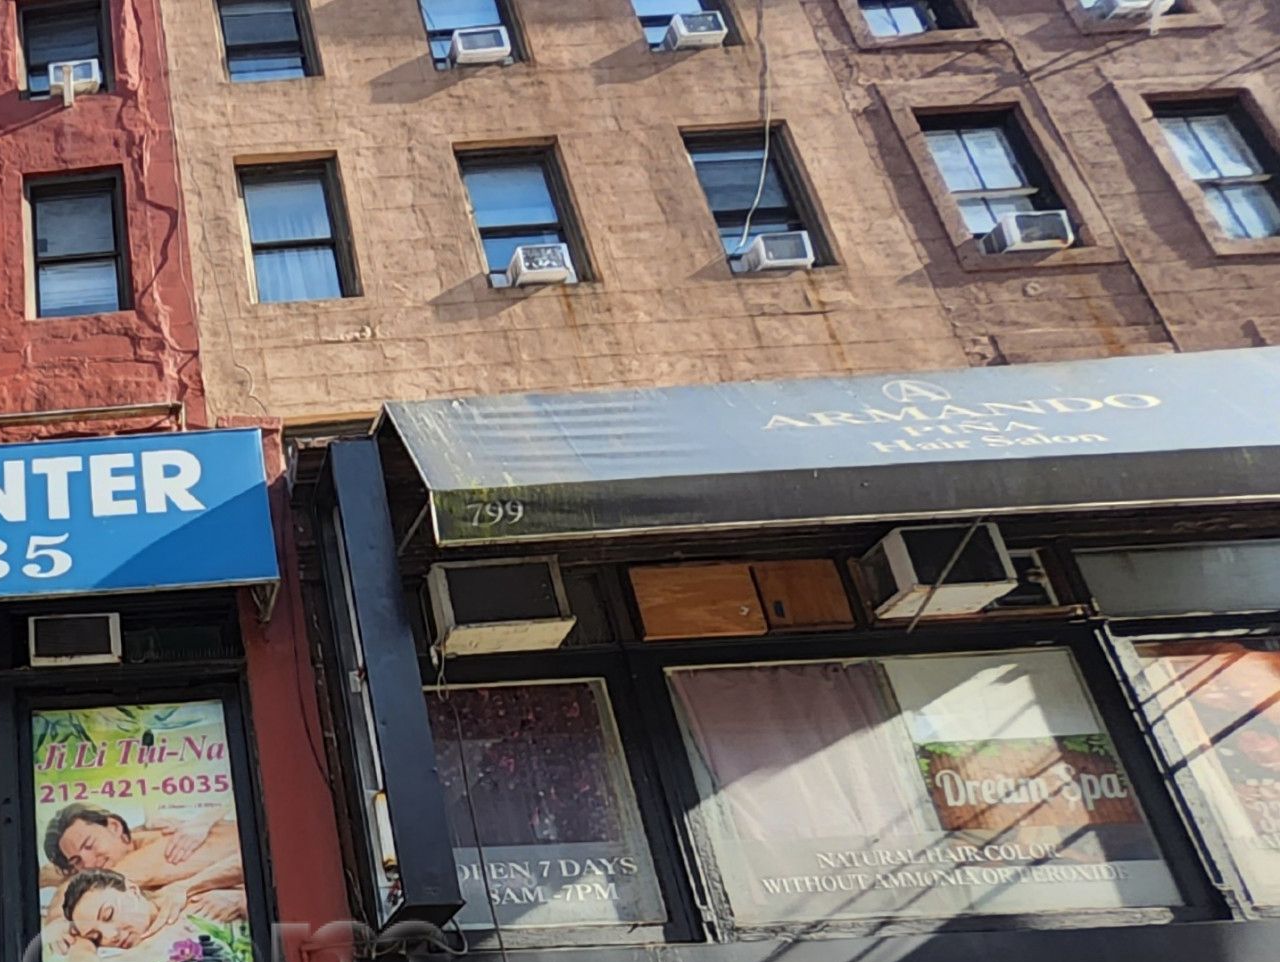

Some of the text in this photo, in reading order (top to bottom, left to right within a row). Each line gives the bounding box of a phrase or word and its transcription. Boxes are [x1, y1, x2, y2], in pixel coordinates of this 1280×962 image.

[762, 393, 1163, 430] ARMANDO
[869, 432, 1110, 453] Hair Salon
[468, 499, 524, 527] 799
[37, 734, 225, 773] Ji Li Tui-Na
[39, 773, 230, 804] 212-421-6035
[935, 764, 1128, 811] Dream Spa
[538, 861, 551, 878] 7
[558, 856, 638, 878] DAYS
[816, 842, 1061, 869] NATURAL HAIR COLOR
[762, 873, 871, 895] WITHOUT
[872, 868, 980, 889] AMMONIA
